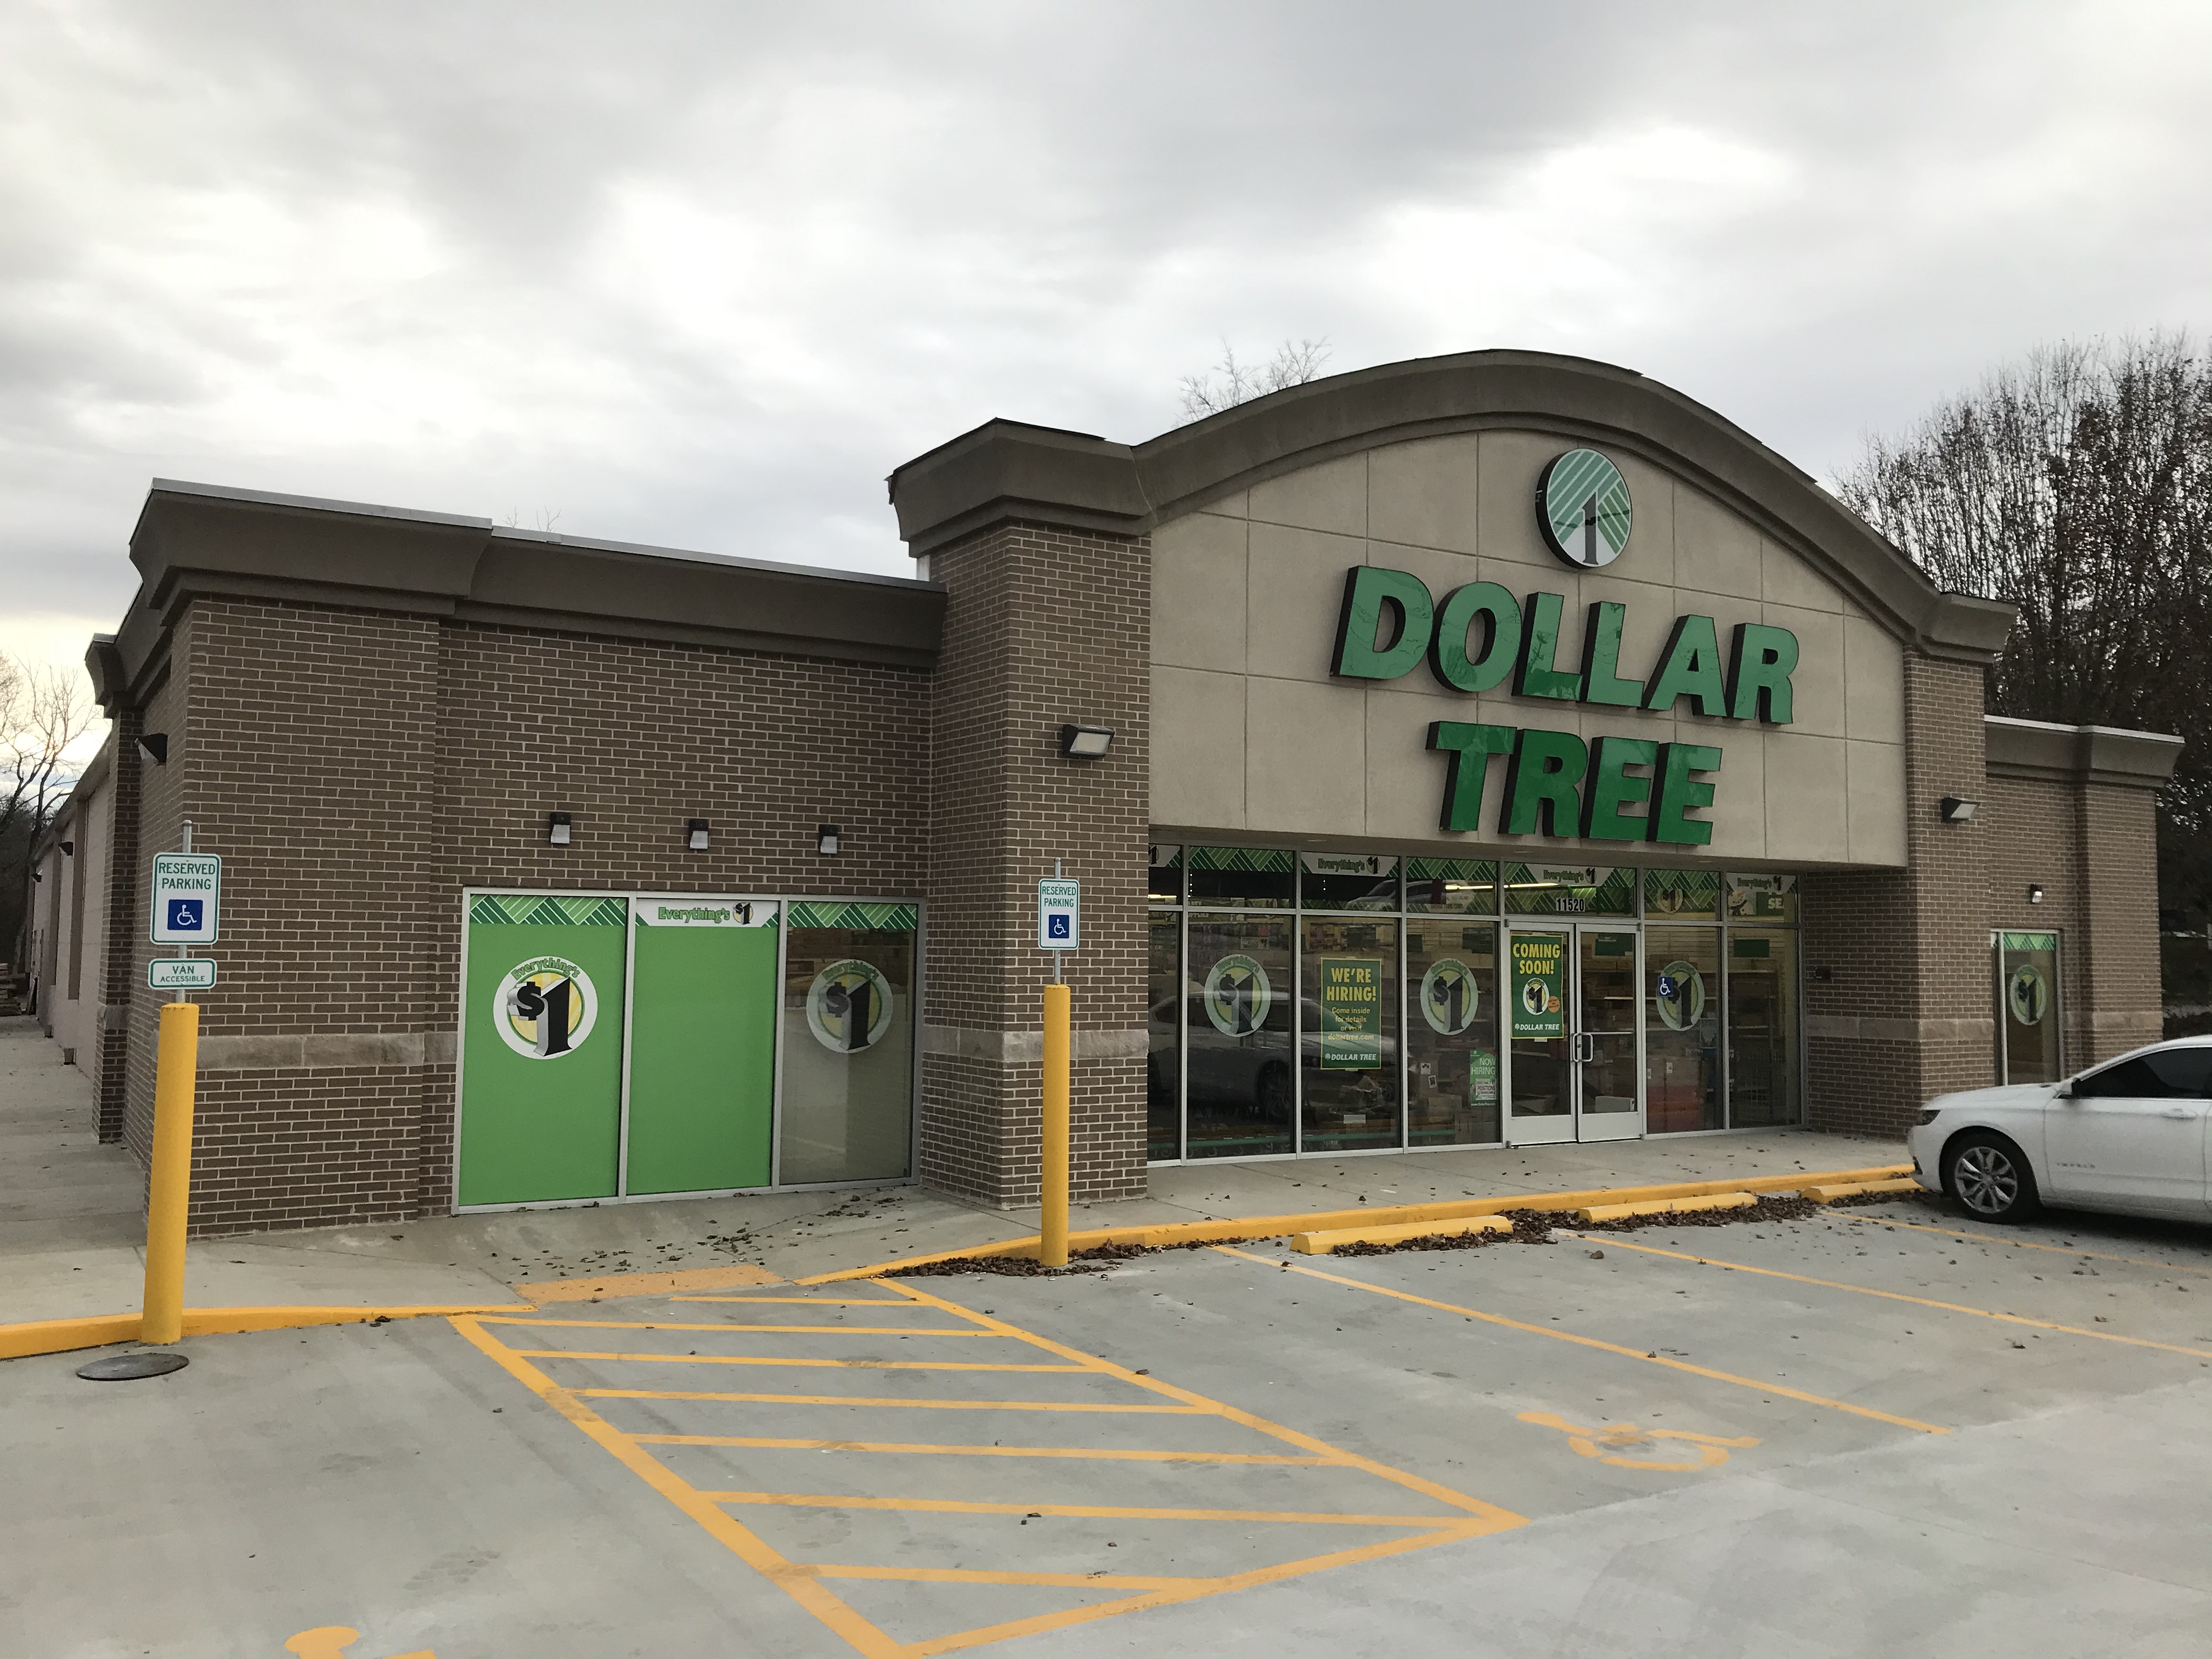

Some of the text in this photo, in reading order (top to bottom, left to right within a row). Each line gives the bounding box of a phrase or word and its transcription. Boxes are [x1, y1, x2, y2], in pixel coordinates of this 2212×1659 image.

[1330, 565, 1799, 724] DOLLAR
[1426, 721, 1722, 845] TREE
[159, 862, 216, 875] RESERVED
[1318, 858, 1365, 873] Everything's
[162, 878, 212, 890] PARKING
[1042, 886, 1076, 895] RESERVED
[1045, 898, 1074, 907] PARKING
[1557, 898, 1584, 911] 11520
[658, 902, 751, 925] Everything's $1
[1513, 943, 1560, 958] COMING
[172, 966, 194, 974] VAN
[511, 957, 580, 980] Everything's
[1519, 960, 1554, 974] SOON!
[1331, 968, 1372, 983] WE'RE
[1327, 986, 1376, 1001] HIRING!
[1428, 975, 1464, 1032] $1
[507, 977, 572, 1057] $1
[818, 979, 871, 1051] $1
[1471, 1067, 1496, 1075] HIRING
